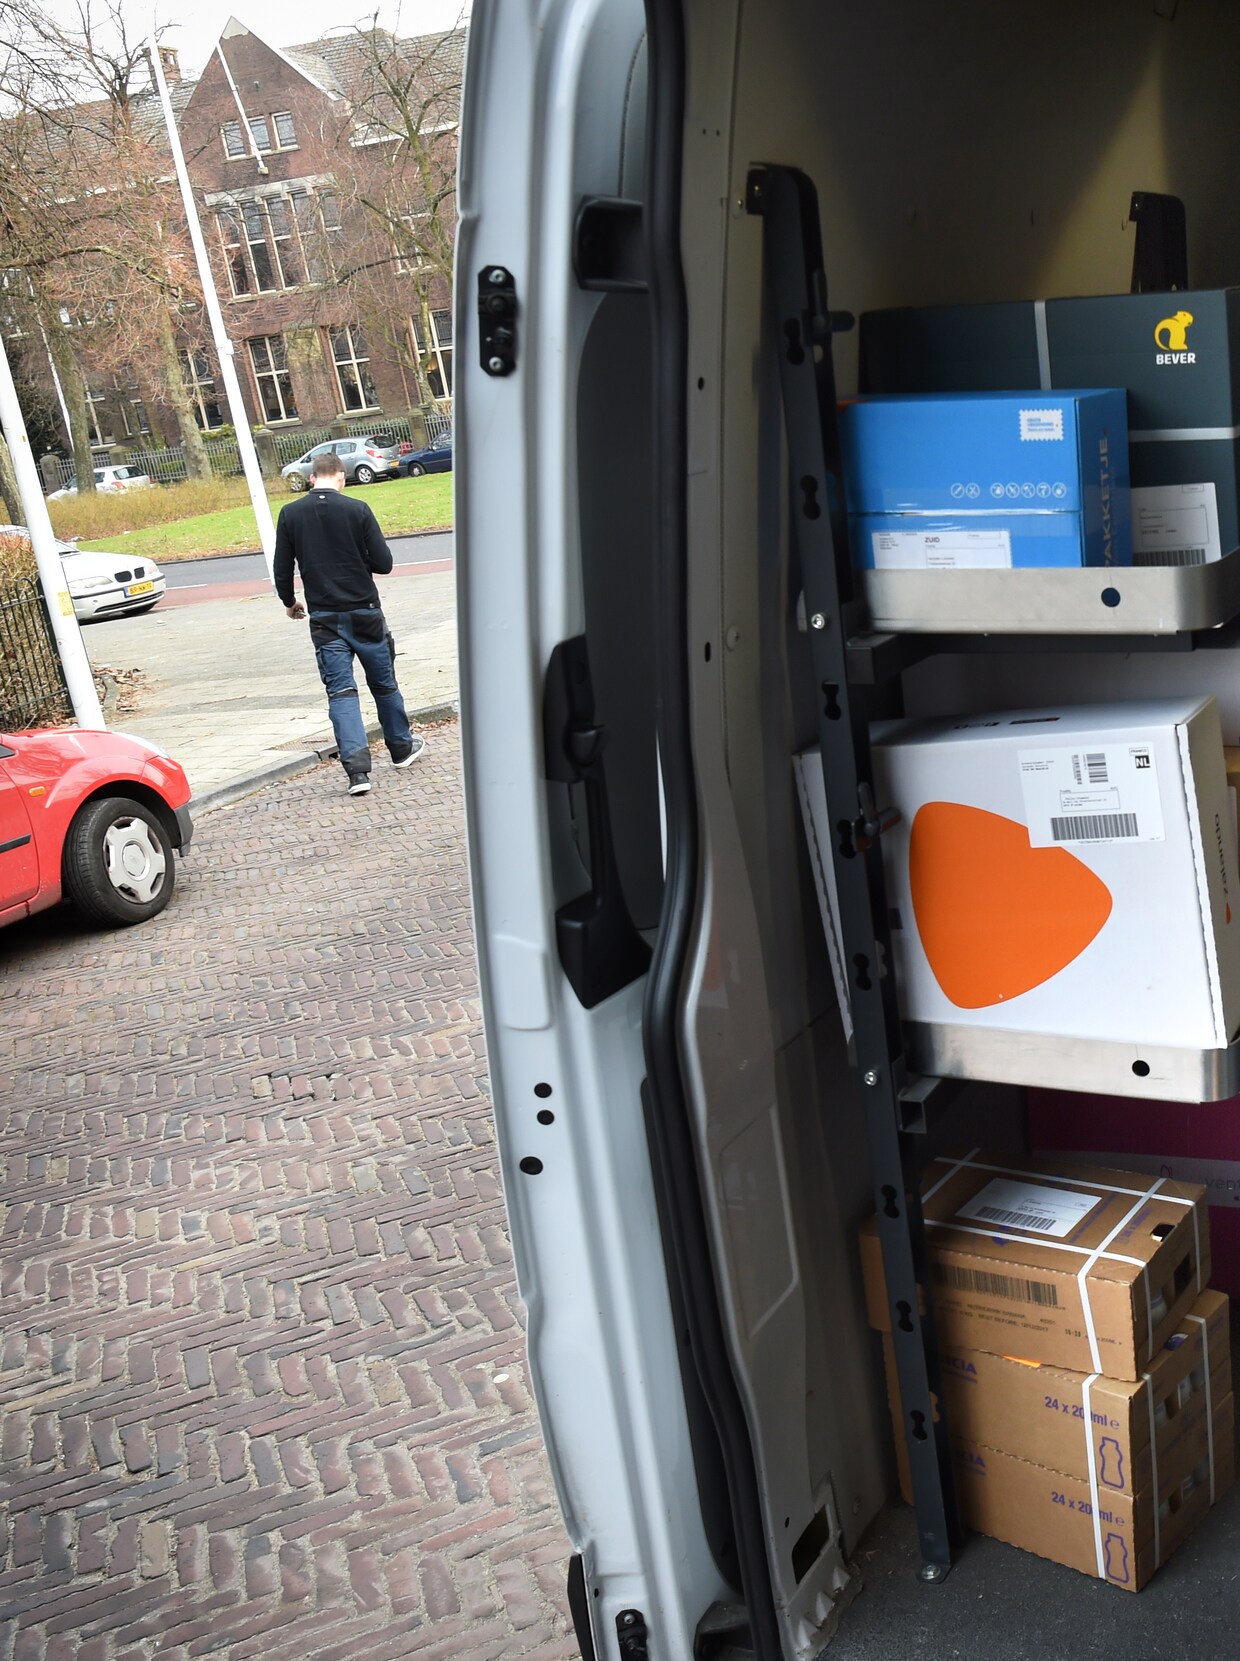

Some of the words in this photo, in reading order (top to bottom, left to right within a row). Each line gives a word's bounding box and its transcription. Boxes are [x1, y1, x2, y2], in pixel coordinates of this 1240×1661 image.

[1156, 352, 1196, 365] BEVER
[1135, 756, 1150, 768] NL
[1214, 813, 1229, 895] zalando
[1045, 1396, 1059, 1411] 24
[1062, 1403, 1069, 1414] x
[1072, 1405, 1107, 1427] 20ml
[1051, 1491, 1066, 1506] 24
[1069, 1499, 1076, 1510] x
[1078, 1501, 1113, 1523] 20ml
